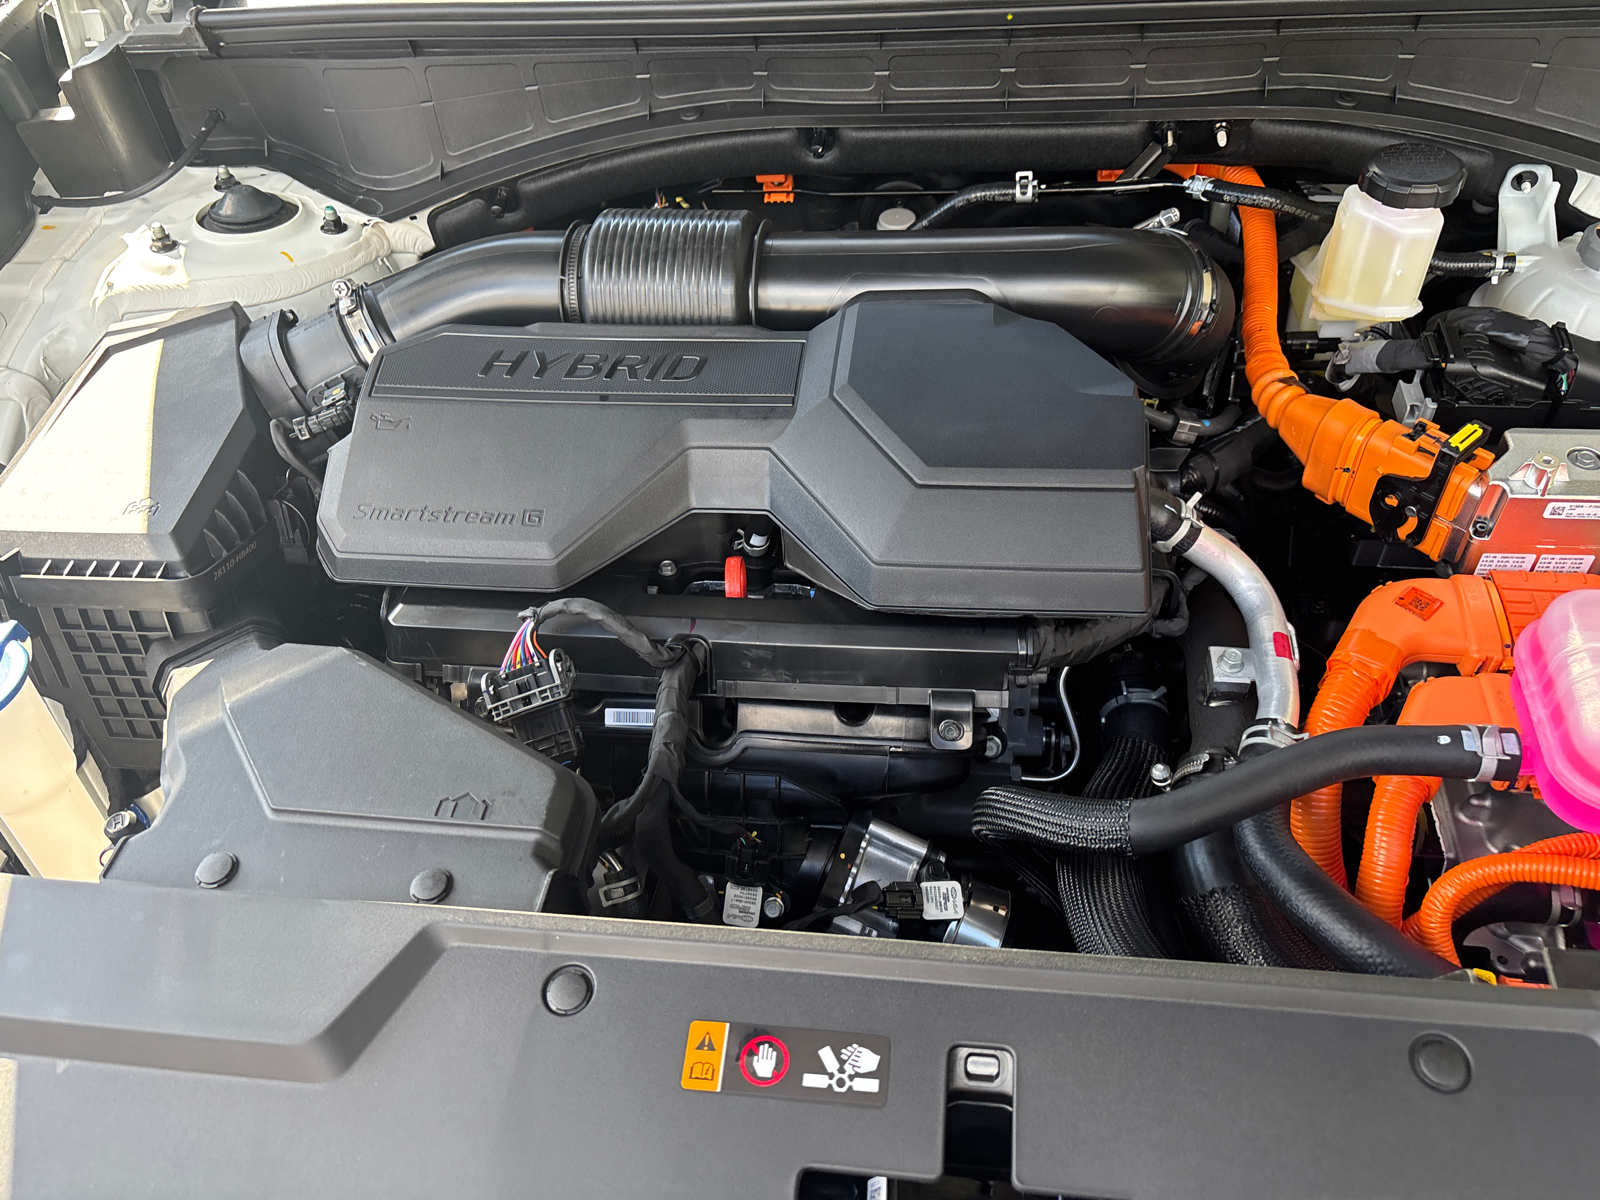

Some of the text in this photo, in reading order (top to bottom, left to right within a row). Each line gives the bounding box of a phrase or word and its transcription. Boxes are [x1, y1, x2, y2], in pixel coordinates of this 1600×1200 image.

[477, 350, 708, 382] HYBRID
[353, 502, 546, 527] Smartstream G
